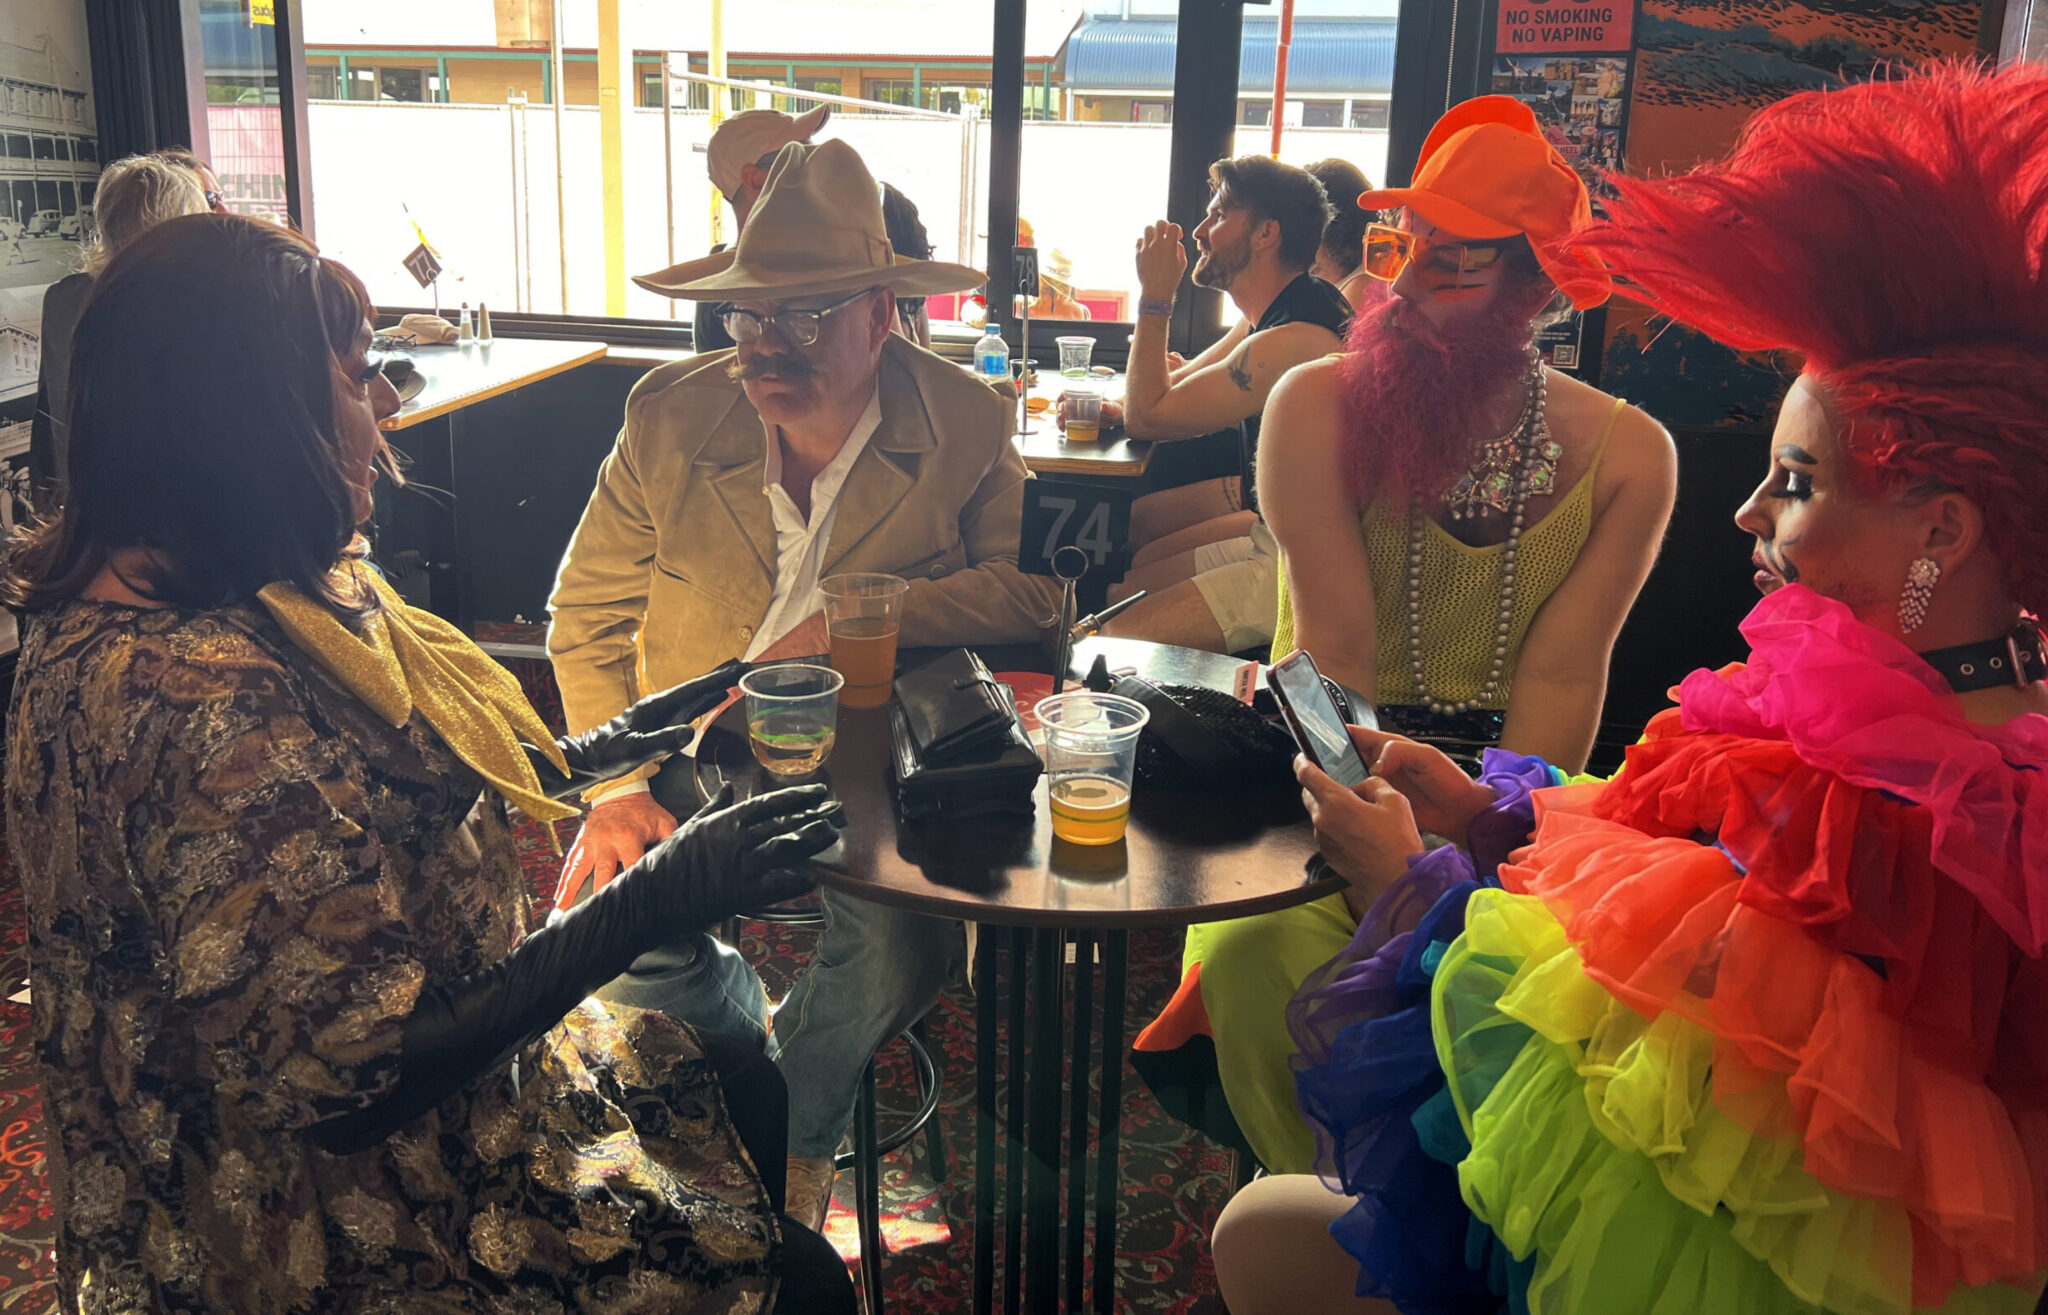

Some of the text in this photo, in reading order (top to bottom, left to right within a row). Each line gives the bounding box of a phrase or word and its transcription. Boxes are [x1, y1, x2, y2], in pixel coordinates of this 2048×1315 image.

[1505, 8, 1613, 25] NO SMOKING
[1512, 26, 1604, 43] NO VAPING
[408, 250, 434, 281] 77
[1015, 255, 1035, 288] 78
[1038, 495, 1112, 566] 74
